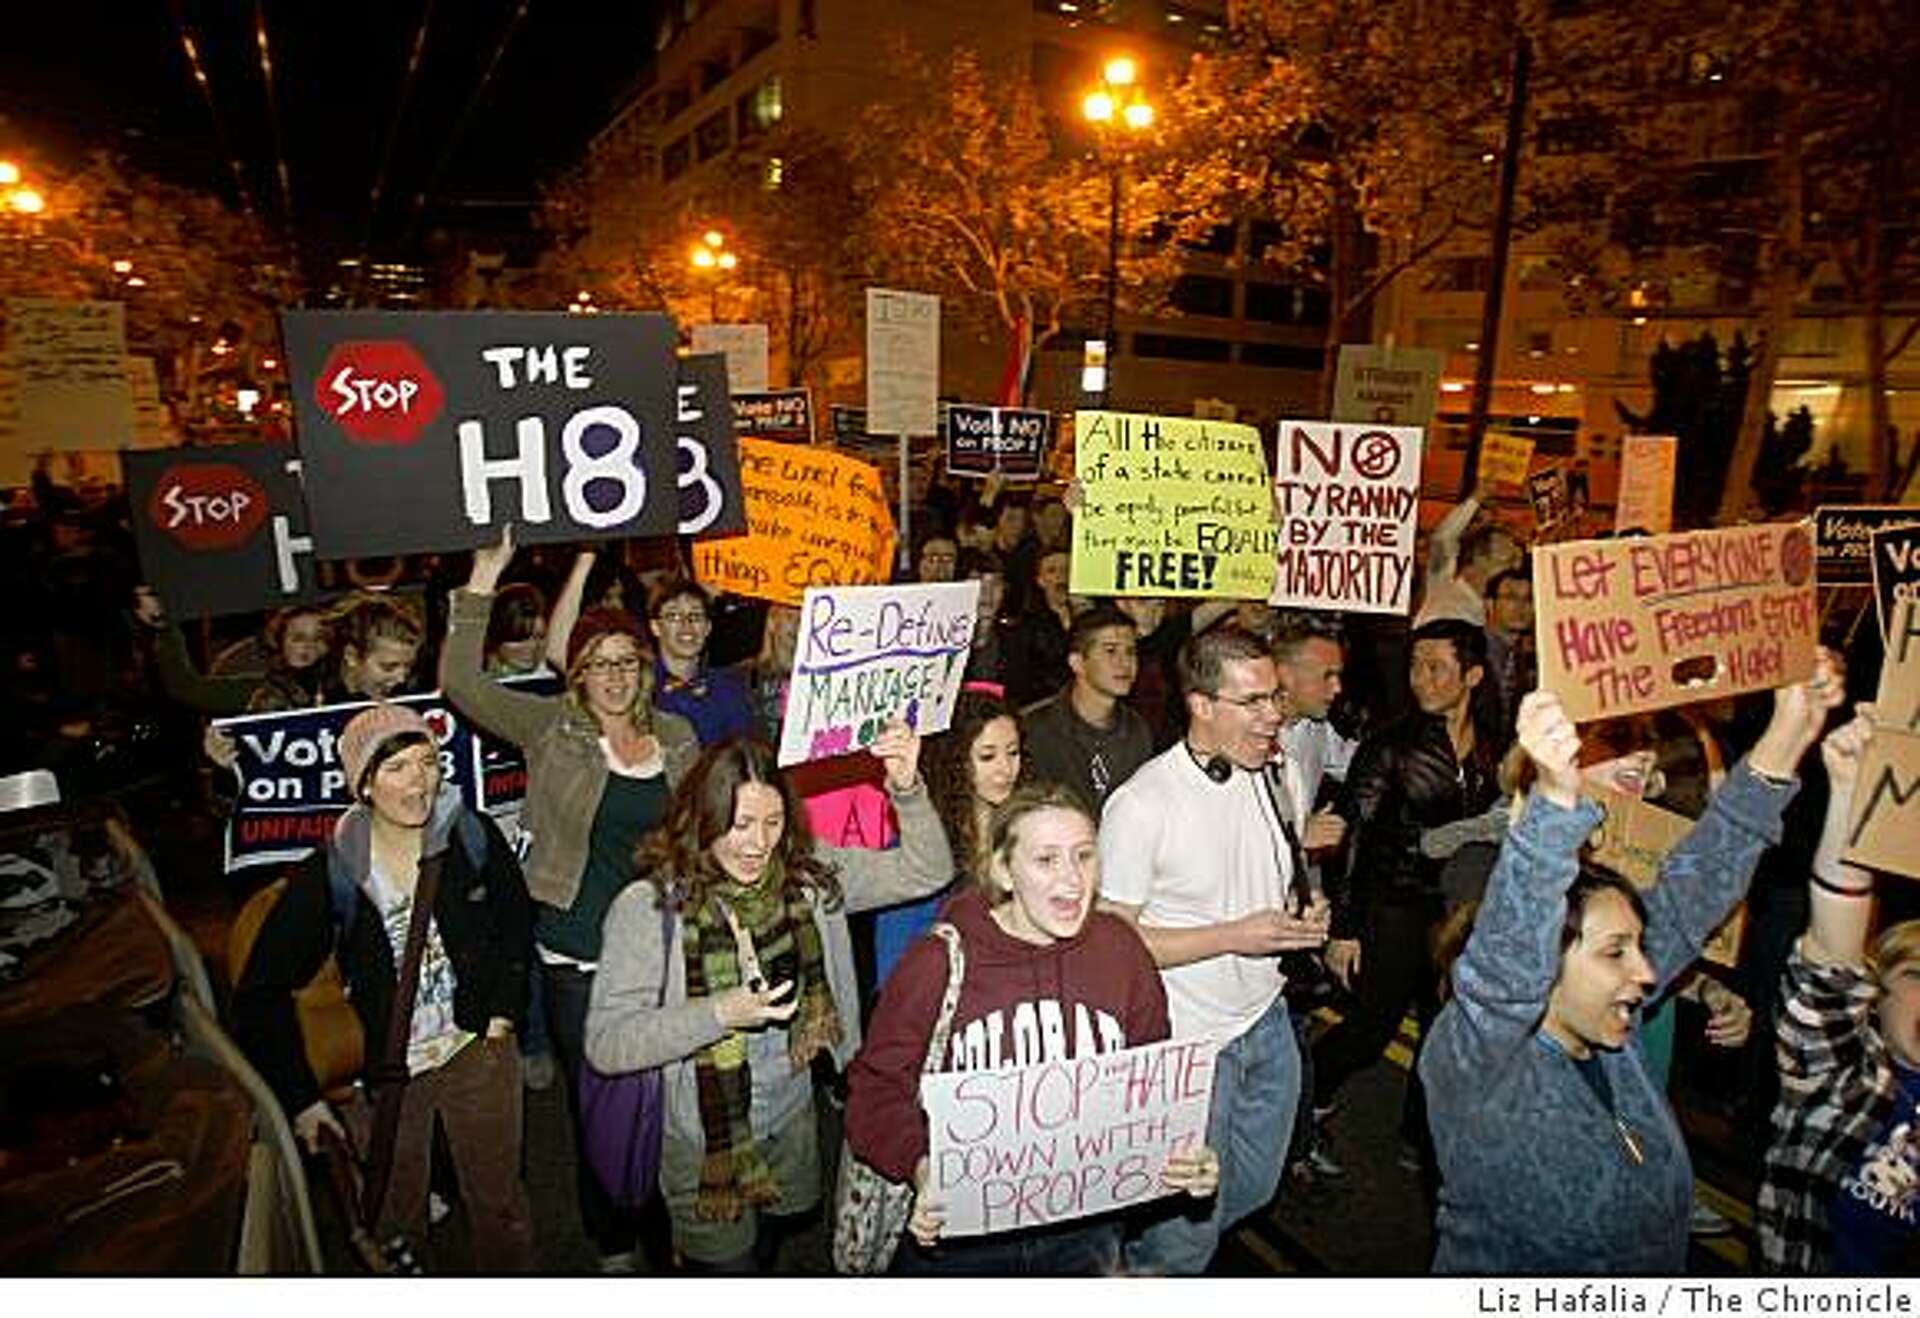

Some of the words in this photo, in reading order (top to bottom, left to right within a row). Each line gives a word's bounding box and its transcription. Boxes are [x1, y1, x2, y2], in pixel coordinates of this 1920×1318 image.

[483, 345, 593, 390] THE
[330, 367, 419, 416] STOP
[1009, 417, 1041, 437] NO
[1082, 415, 1130, 451] All
[457, 405, 648, 529] H8
[1083, 453, 1110, 484] of
[1291, 427, 1400, 480] NO
[164, 485, 250, 528] STOP
[1277, 482, 1419, 524] TYRANNY
[1290, 519, 1330, 545] BY
[1342, 521, 1398, 547] THE
[1115, 551, 1218, 590] FREE!
[1552, 549, 1617, 598] Let
[1629, 532, 1775, 597] EVERYONE
[1556, 616, 1639, 671] Have
[1584, 664, 1655, 708] The
[243, 728, 338, 767] Vot
[247, 777, 303, 801] on
[945, 1058, 1101, 1145] STOP
[1124, 1040, 1213, 1114] HATE
[939, 1136, 1058, 1192] DOWN
[1074, 1113, 1168, 1161] WITH
[980, 1162, 1107, 1233] PROP
